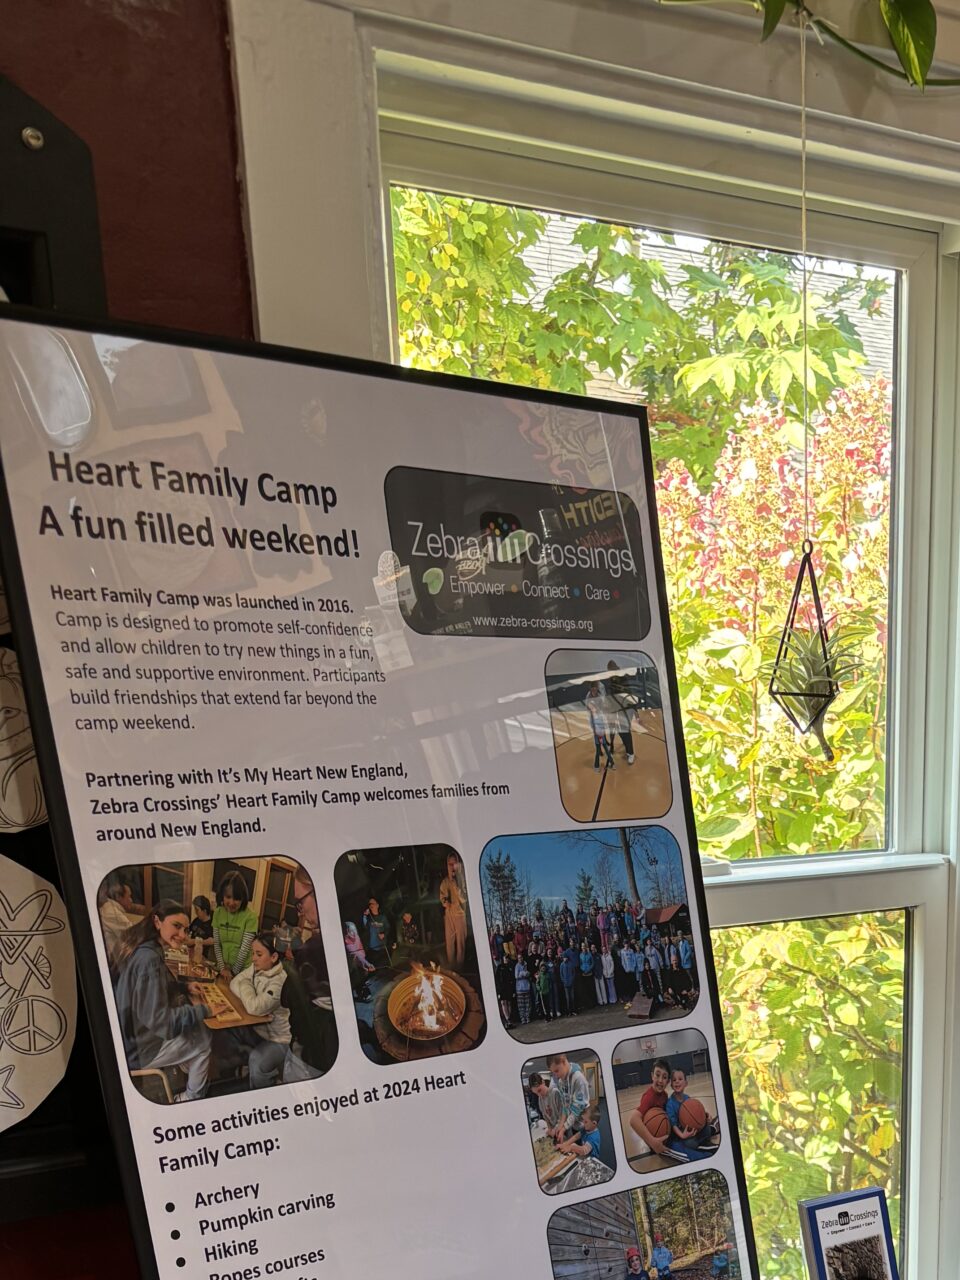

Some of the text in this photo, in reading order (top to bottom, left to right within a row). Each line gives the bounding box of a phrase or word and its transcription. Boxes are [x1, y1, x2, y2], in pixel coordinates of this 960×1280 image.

[48, 450, 338, 514] Heart Family Camp
[38, 505, 360, 559] A fun filled weekend!
[407, 521, 632, 578] Zebra Crossings
[50, 584, 354, 614] Heart Family Camp was launched in 2016.
[450, 576, 610, 601] Empower Connect Care
[473, 616, 593, 632] www.zebra-crossings.org
[85, 762, 408, 789] Partnering with It’s My Heart New England,
[152, 1070, 467, 1145] Some activities enjoyed at 2024 Heart
[158, 1137, 281, 1174] Family Camp:
[194, 1182, 260, 1209] Archery
[198, 1193, 336, 1236] Pumpkin carving
[821, 1220, 838, 1229] Zebra
[850, 1209, 878, 1222] Crossings
[204, 1238, 259, 1263] Hiking
[264, 1249, 326, 1275] courses
